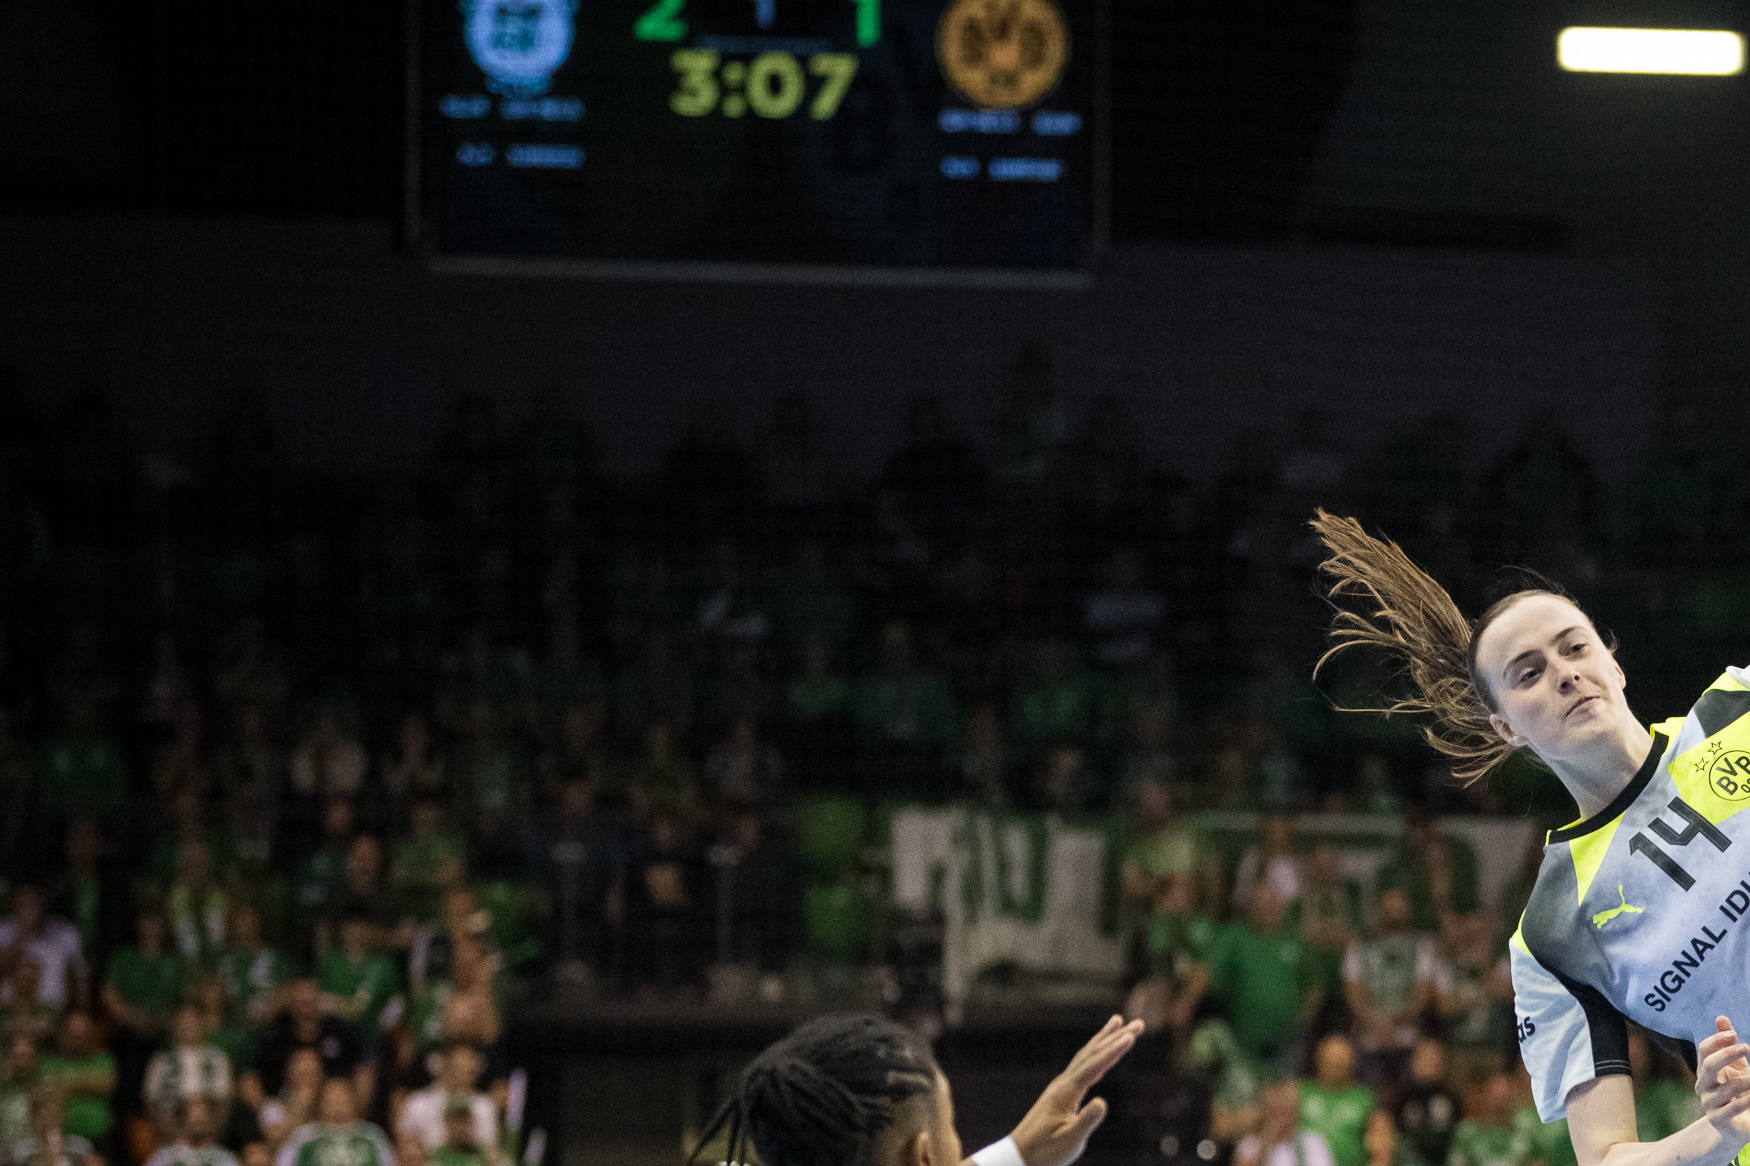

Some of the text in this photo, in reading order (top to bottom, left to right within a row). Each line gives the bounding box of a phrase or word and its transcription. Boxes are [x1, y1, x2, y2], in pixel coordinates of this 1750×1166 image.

[670, 49, 858, 120] 3:07
[1629, 796, 1732, 892] 14
[1644, 925, 1728, 1012] SIGNAL
